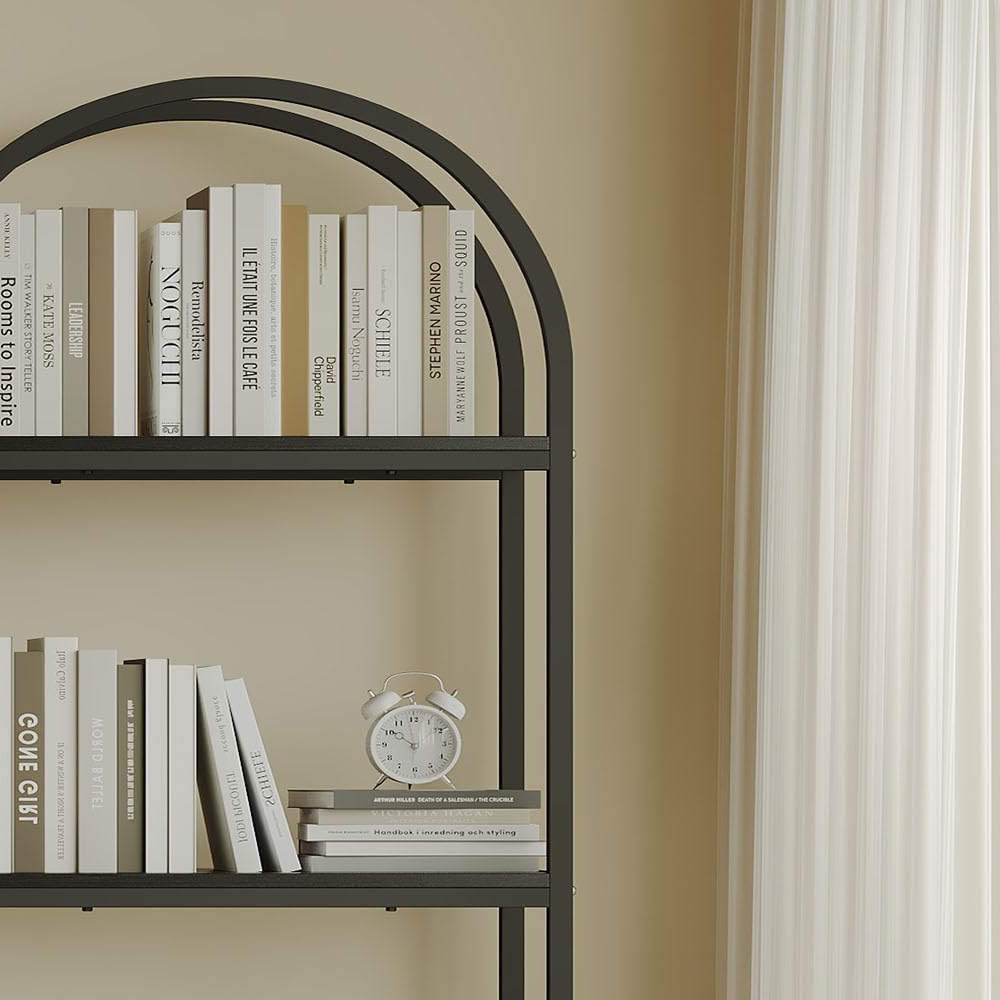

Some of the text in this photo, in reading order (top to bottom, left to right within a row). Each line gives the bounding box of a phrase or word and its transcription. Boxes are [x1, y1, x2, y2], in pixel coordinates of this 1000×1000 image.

[454, 229, 468, 267] SQUID
[0, 277, 16, 336] Rooms
[24, 274, 33, 393] TIM WALKER STORY TELLER
[42, 294, 55, 369] KATE MOSS
[68, 302, 84, 359] LEADERSHIP
[161, 266, 181, 386] NOGUCHI
[191, 280, 206, 361] Remodelista
[242, 247, 261, 391] IL ÉTAIT UNE FOIS LE CAFÉ
[349, 287, 365, 382] Isamu Noguchi
[429, 261, 442, 379] STEPHEN MARINO
[454, 295, 468, 344] PROUST
[0, 341, 15, 360] to
[326, 356, 337, 384] David
[374, 308, 392, 378] SCHIELE
[313, 356, 325, 417] Chipperfield
[421, 829, 465, 838] inredning
[486, 829, 517, 838] styling
